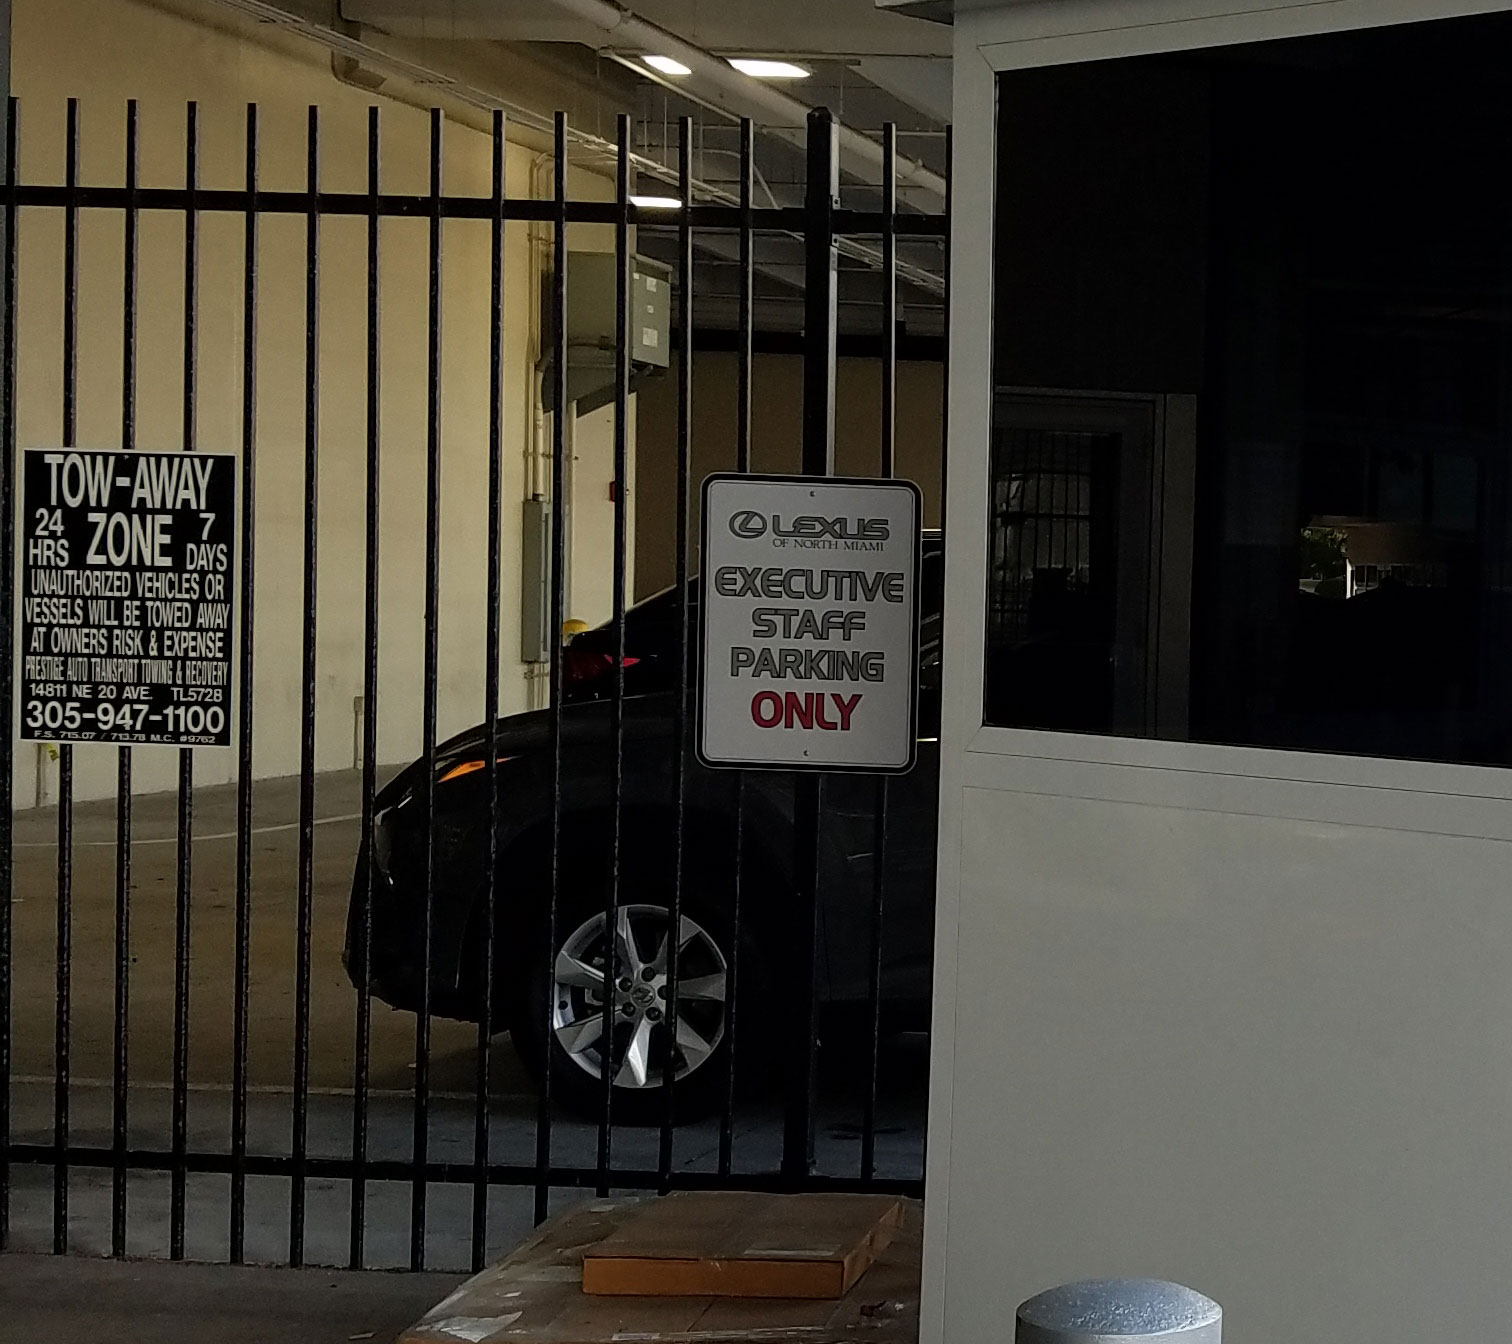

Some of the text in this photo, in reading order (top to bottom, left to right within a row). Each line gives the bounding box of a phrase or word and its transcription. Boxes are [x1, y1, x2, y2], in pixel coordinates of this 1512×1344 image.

[44, 453, 214, 510] TOW-AWAY
[35, 508, 65, 536] 24
[199, 513, 216, 541] 7
[772, 515, 890, 541] LEXUS
[29, 539, 69, 567] HRS
[86, 512, 173, 567] ZONE
[772, 538, 884, 552] OF NORTH MIAMI
[186, 543, 227, 571] DAYS
[31, 569, 225, 600] UNAUTHORIZED VEHICLES OR
[714, 566, 904, 603] EXECUTIVE
[25, 597, 230, 629] VESSELS WILL BE TOWED AWAY
[752, 607, 866, 641] STAFF
[30, 627, 224, 658] AT OWNERS RISK & EXPENSE
[25, 656, 229, 686] PRESTIGE AUTO TRANSPORT TOWING & RECOVERY
[730, 647, 885, 683] PARKING
[29, 683, 67, 697] 14811
[72, 685, 93, 698] NE
[98, 685, 117, 699] 20
[171, 687, 222, 702] TL5728
[26, 700, 225, 734] 305-947-1100
[751, 690, 863, 731] ONLY
